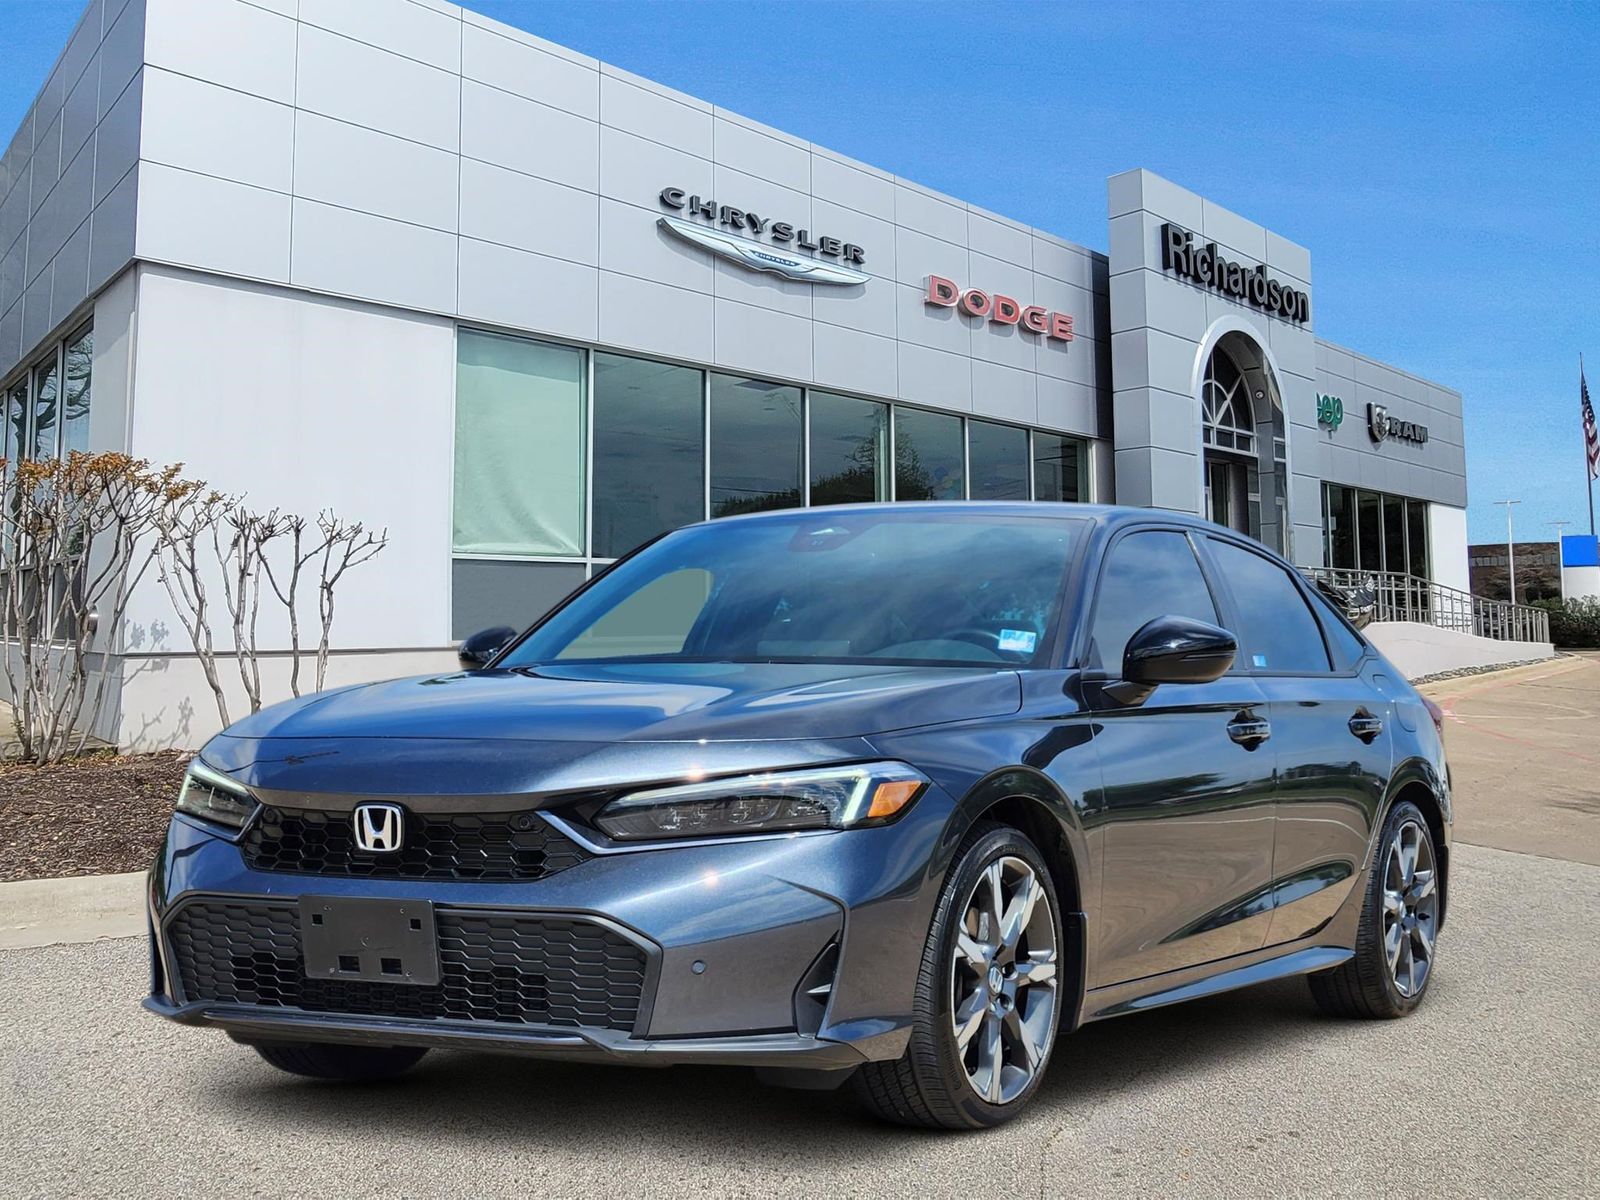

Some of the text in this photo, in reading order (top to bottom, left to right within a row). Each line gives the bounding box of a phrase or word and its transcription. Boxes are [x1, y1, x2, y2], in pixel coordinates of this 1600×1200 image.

[659, 187, 866, 264] CHRYSLER
[1161, 223, 1310, 324] Richardson
[924, 274, 1074, 342] DODGE
[1316, 392, 1344, 430] ep
[1388, 416, 1429, 443] RAM
